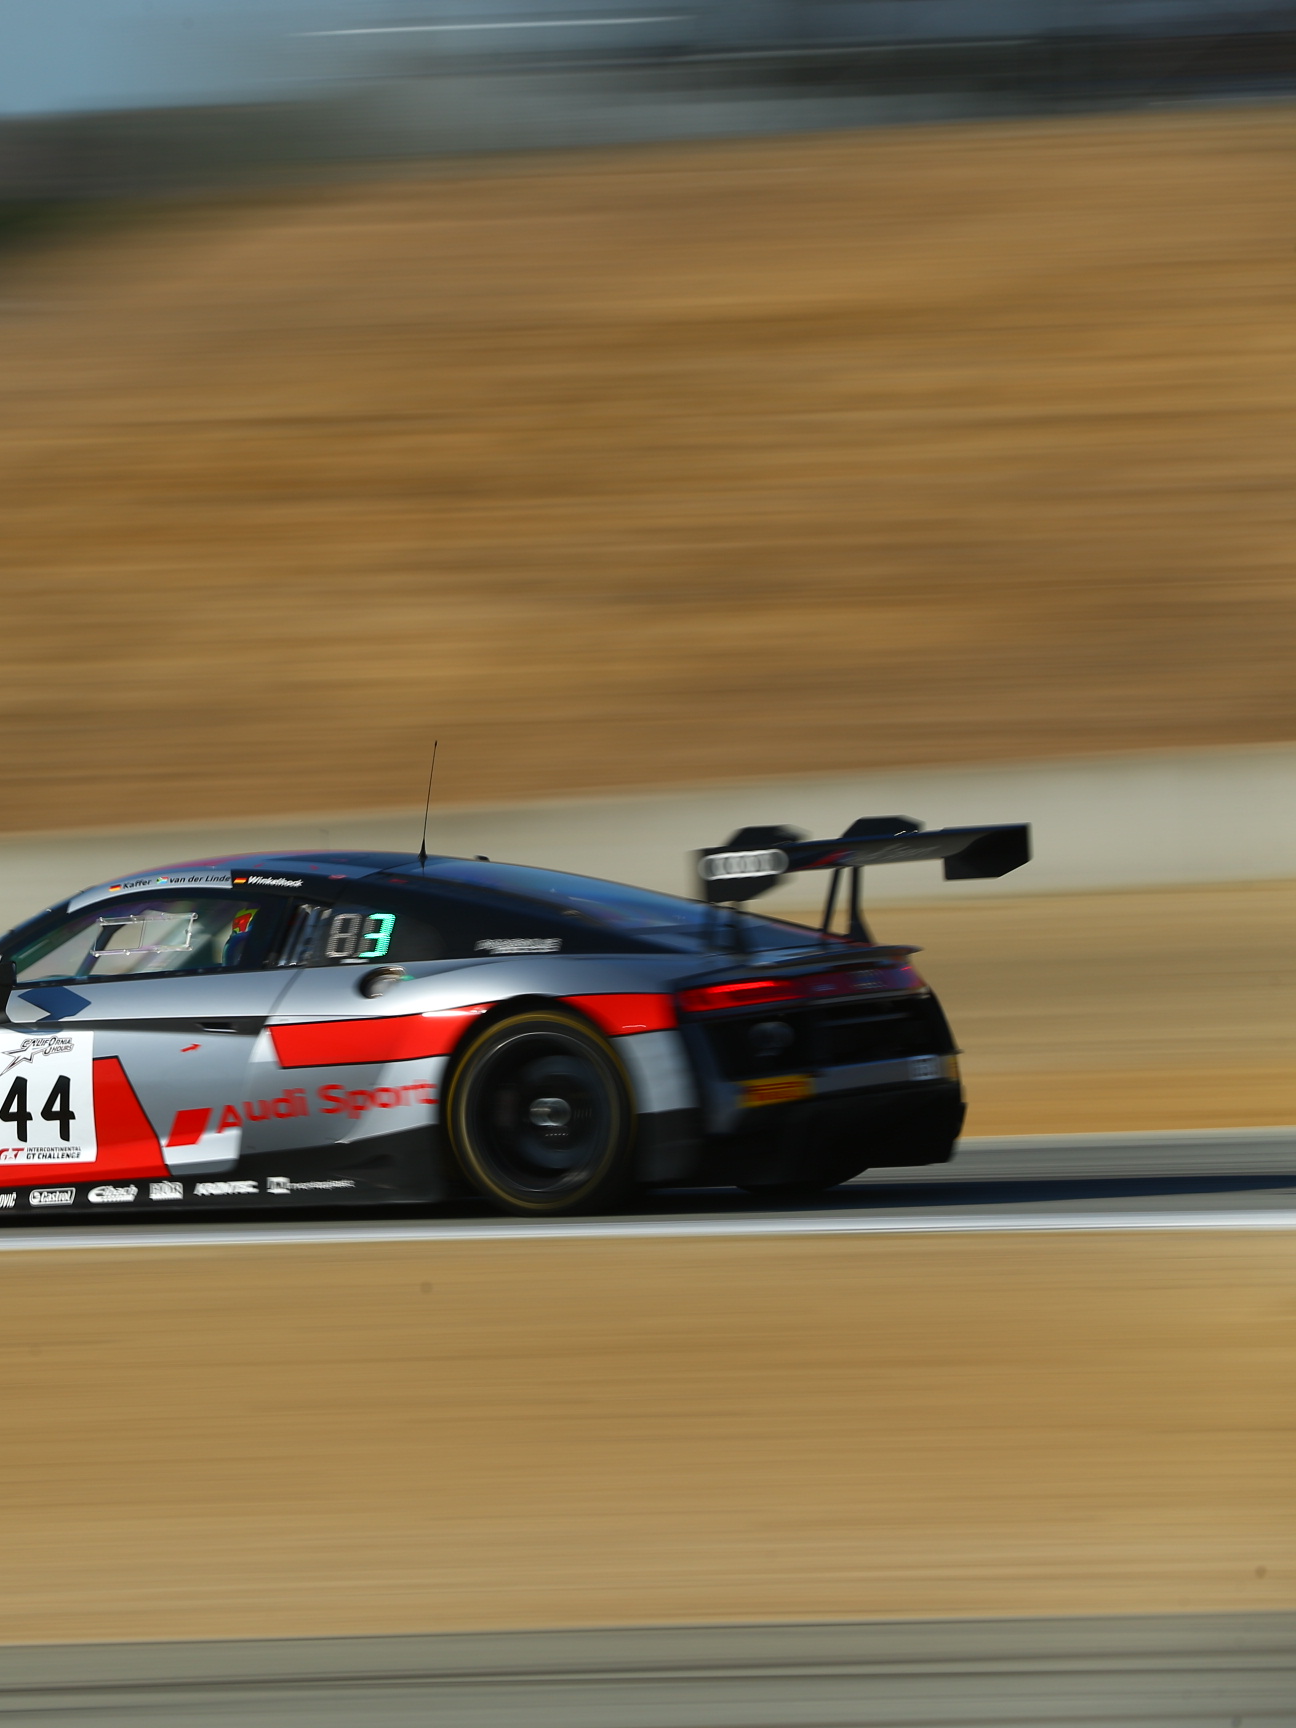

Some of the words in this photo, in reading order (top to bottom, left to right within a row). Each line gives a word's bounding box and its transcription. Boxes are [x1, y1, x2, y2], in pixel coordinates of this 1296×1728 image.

[122, 878, 152, 890] Kaffer
[187, 875, 204, 883] der
[205, 874, 232, 883] Linde
[21, 1036, 72, 1048] CALIFORNIA
[215, 1088, 310, 1134] Audi
[317, 1080, 439, 1120] Sport
[37, 1152, 81, 1160] CHALLENGE
[40, 1190, 72, 1204] Castrol
